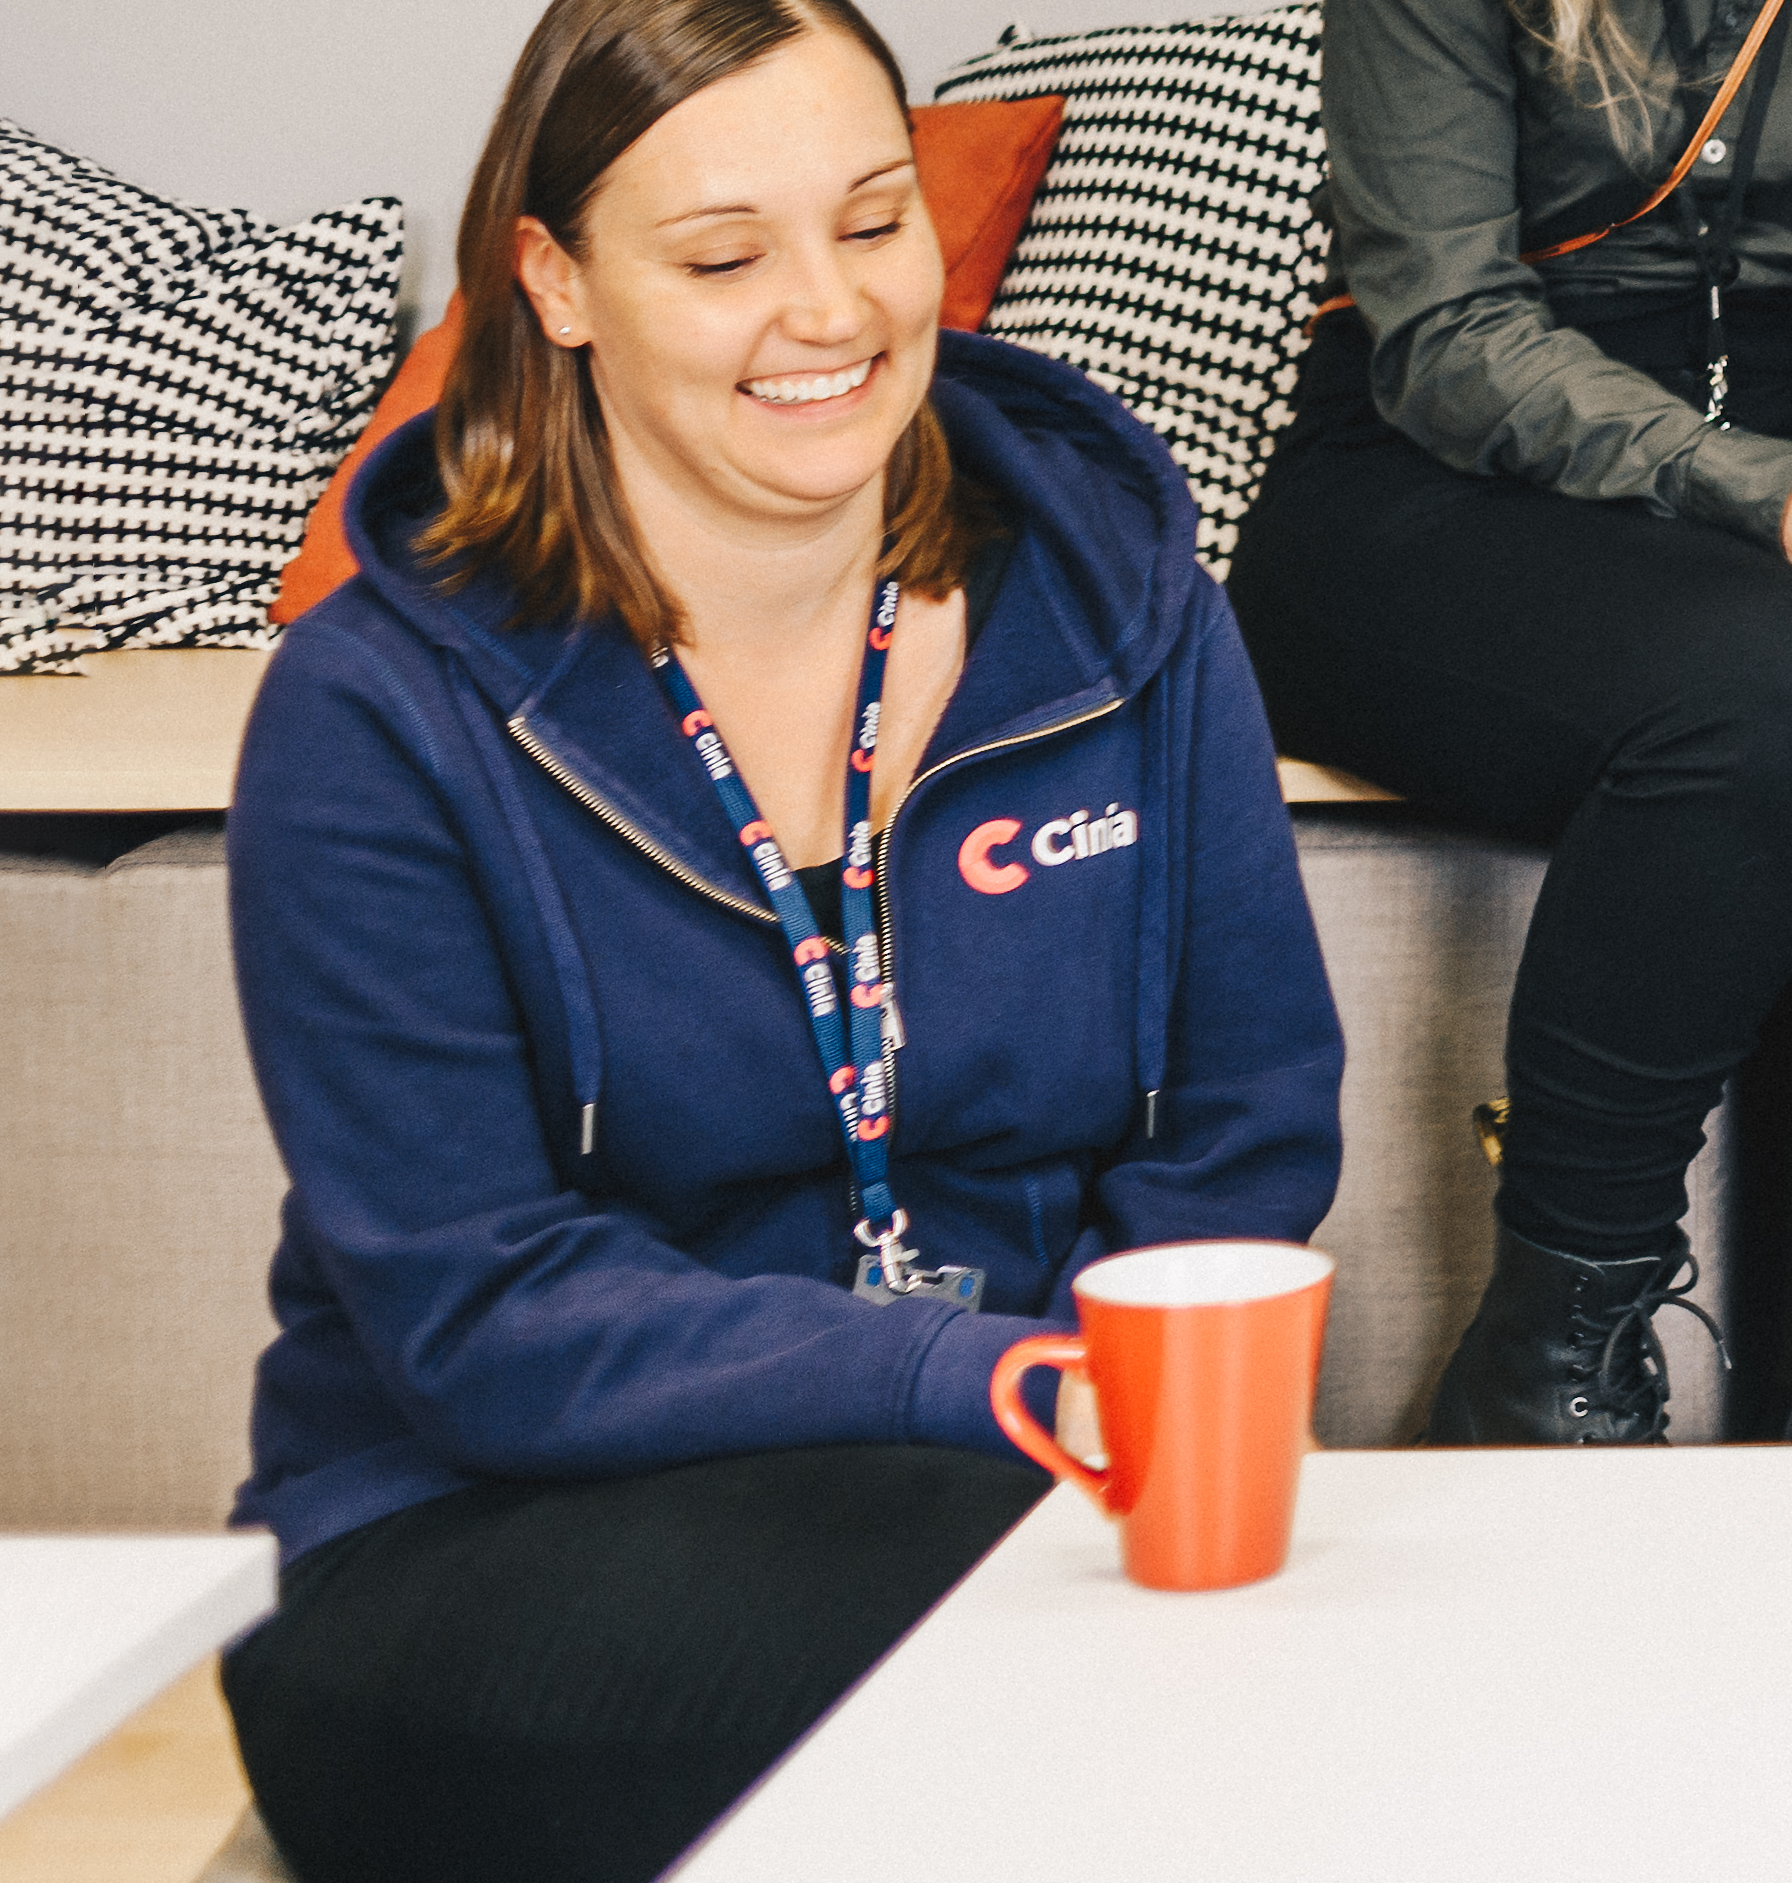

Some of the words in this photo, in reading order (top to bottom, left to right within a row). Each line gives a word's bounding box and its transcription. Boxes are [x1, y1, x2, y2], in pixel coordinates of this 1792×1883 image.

[849, 820, 871, 867] Cinia
[1031, 802, 1138, 866] Cinia
[852, 932, 880, 982] Cinia
[859, 1060, 886, 1116] Cinia
